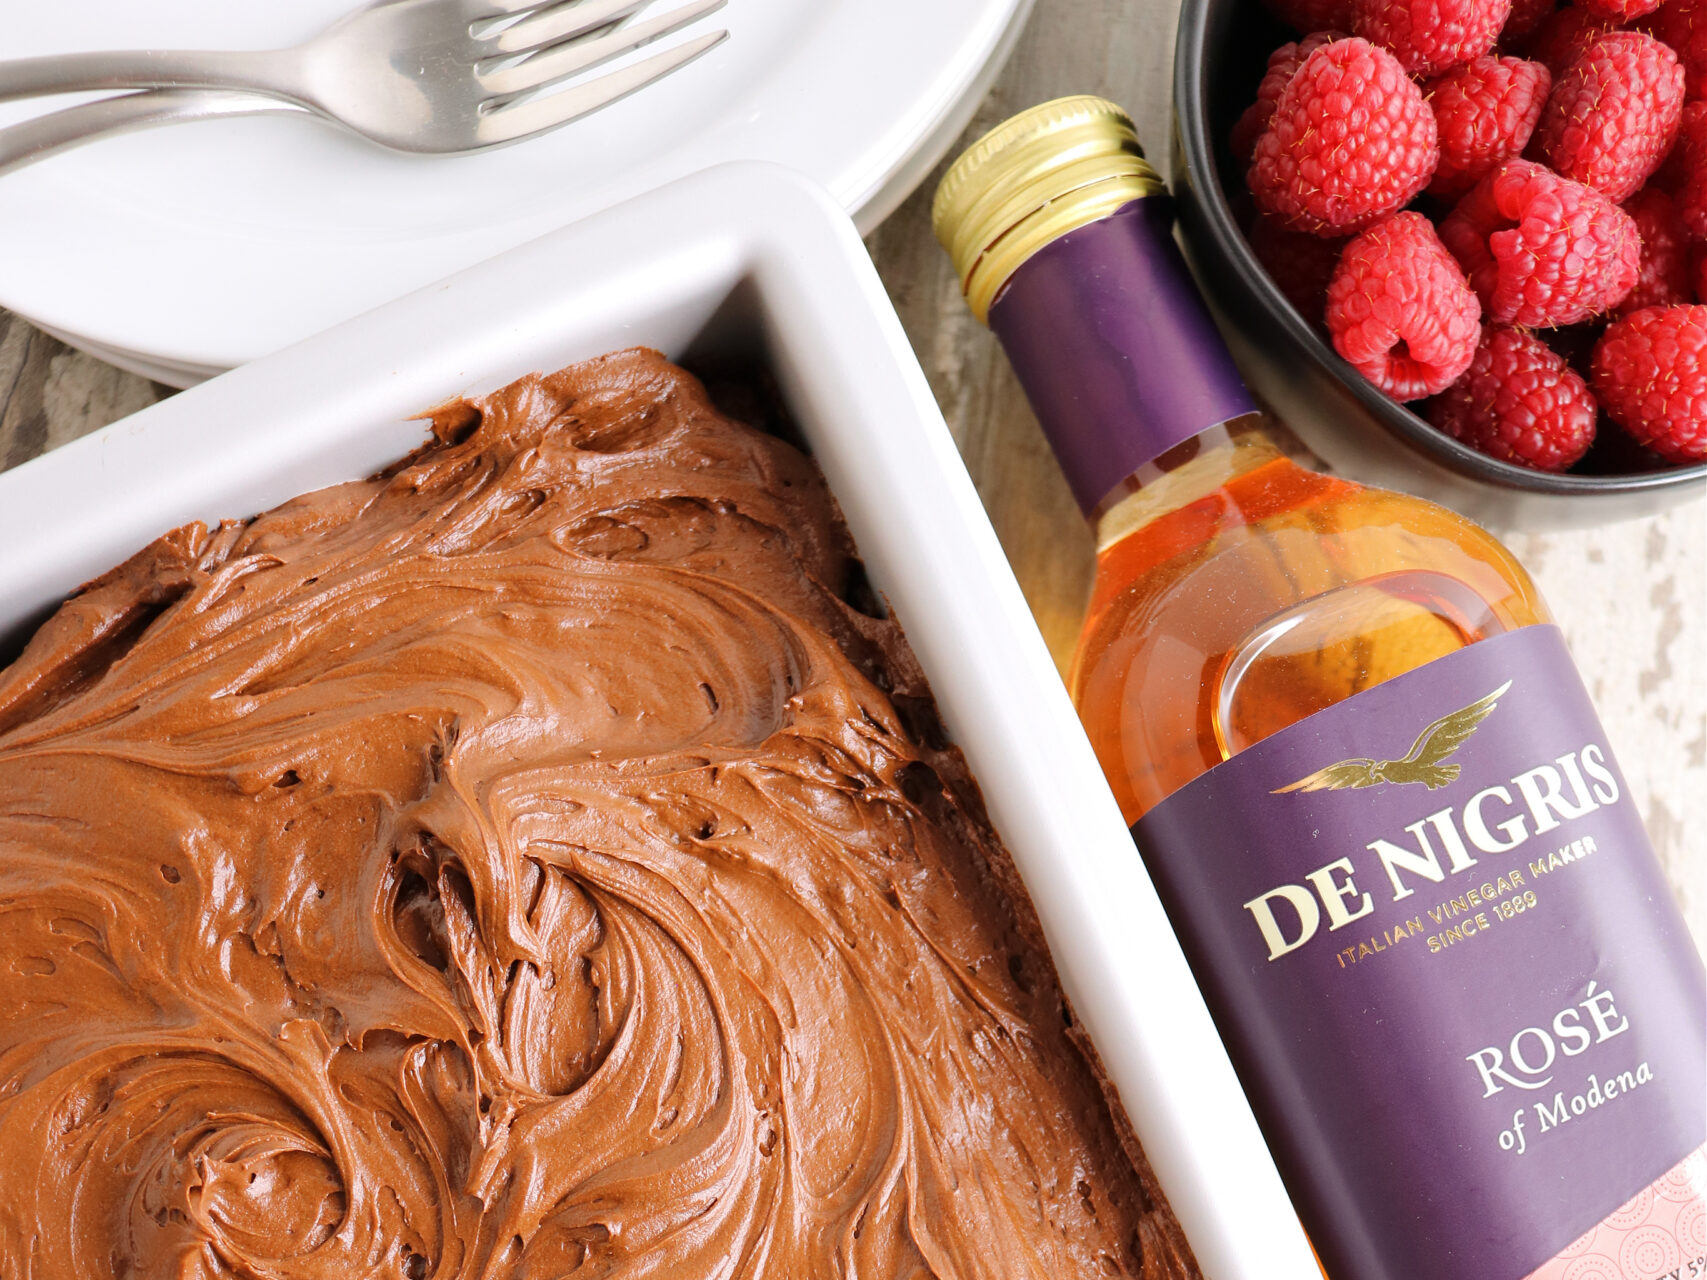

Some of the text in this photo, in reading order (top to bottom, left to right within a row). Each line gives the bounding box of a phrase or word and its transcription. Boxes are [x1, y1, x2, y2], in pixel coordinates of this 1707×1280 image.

[1243, 744, 1620, 962] DE NIGRIS
[1336, 835, 1598, 968] ITALIAN VINEGAR MAKER
[1426, 890, 1538, 953] SINCE 1889
[1465, 980, 1630, 1099] ROSÉ
[1498, 1062, 1654, 1155] of Modena
